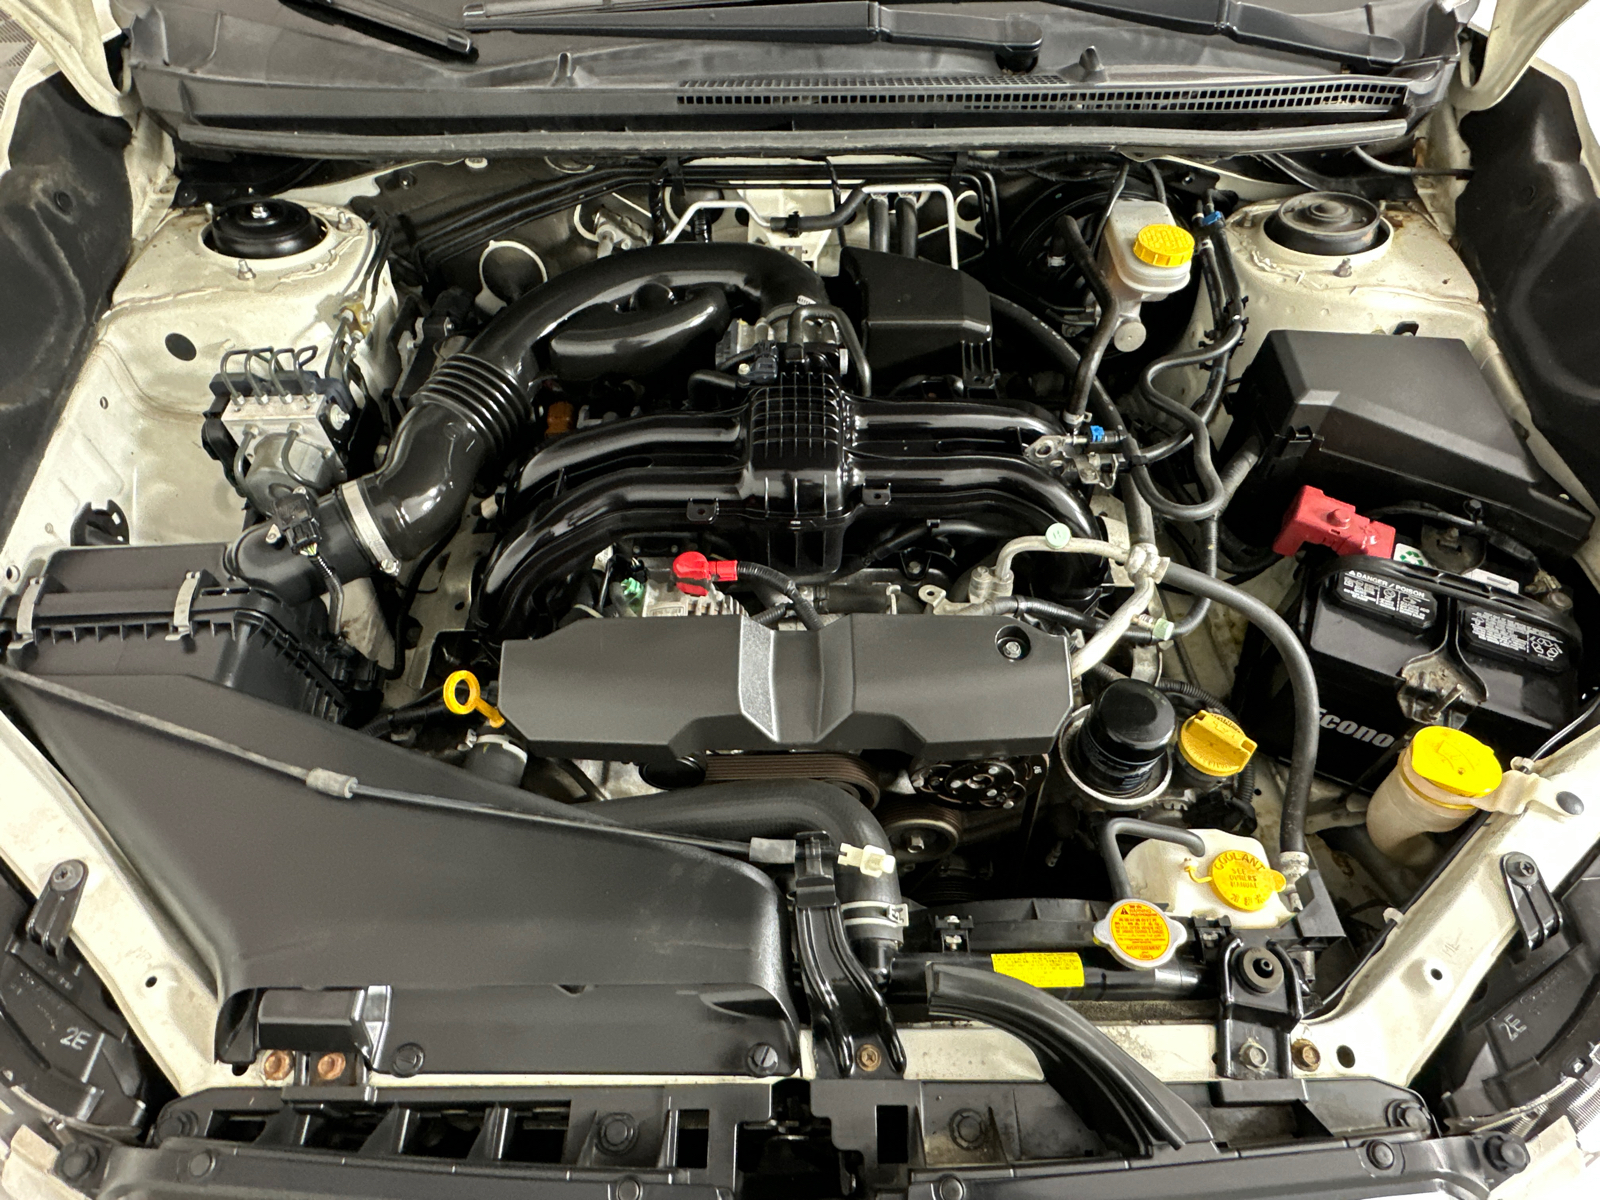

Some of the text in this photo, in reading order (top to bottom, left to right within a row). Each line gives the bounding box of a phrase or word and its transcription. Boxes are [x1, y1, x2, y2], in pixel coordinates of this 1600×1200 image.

[1356, 570, 1389, 587] DANGER
[1395, 584, 1425, 598] POISON
[1214, 852, 1266, 871] COOLANT
[59, 1026, 93, 1051] 2E
[1499, 1013, 1528, 1042] 2E
